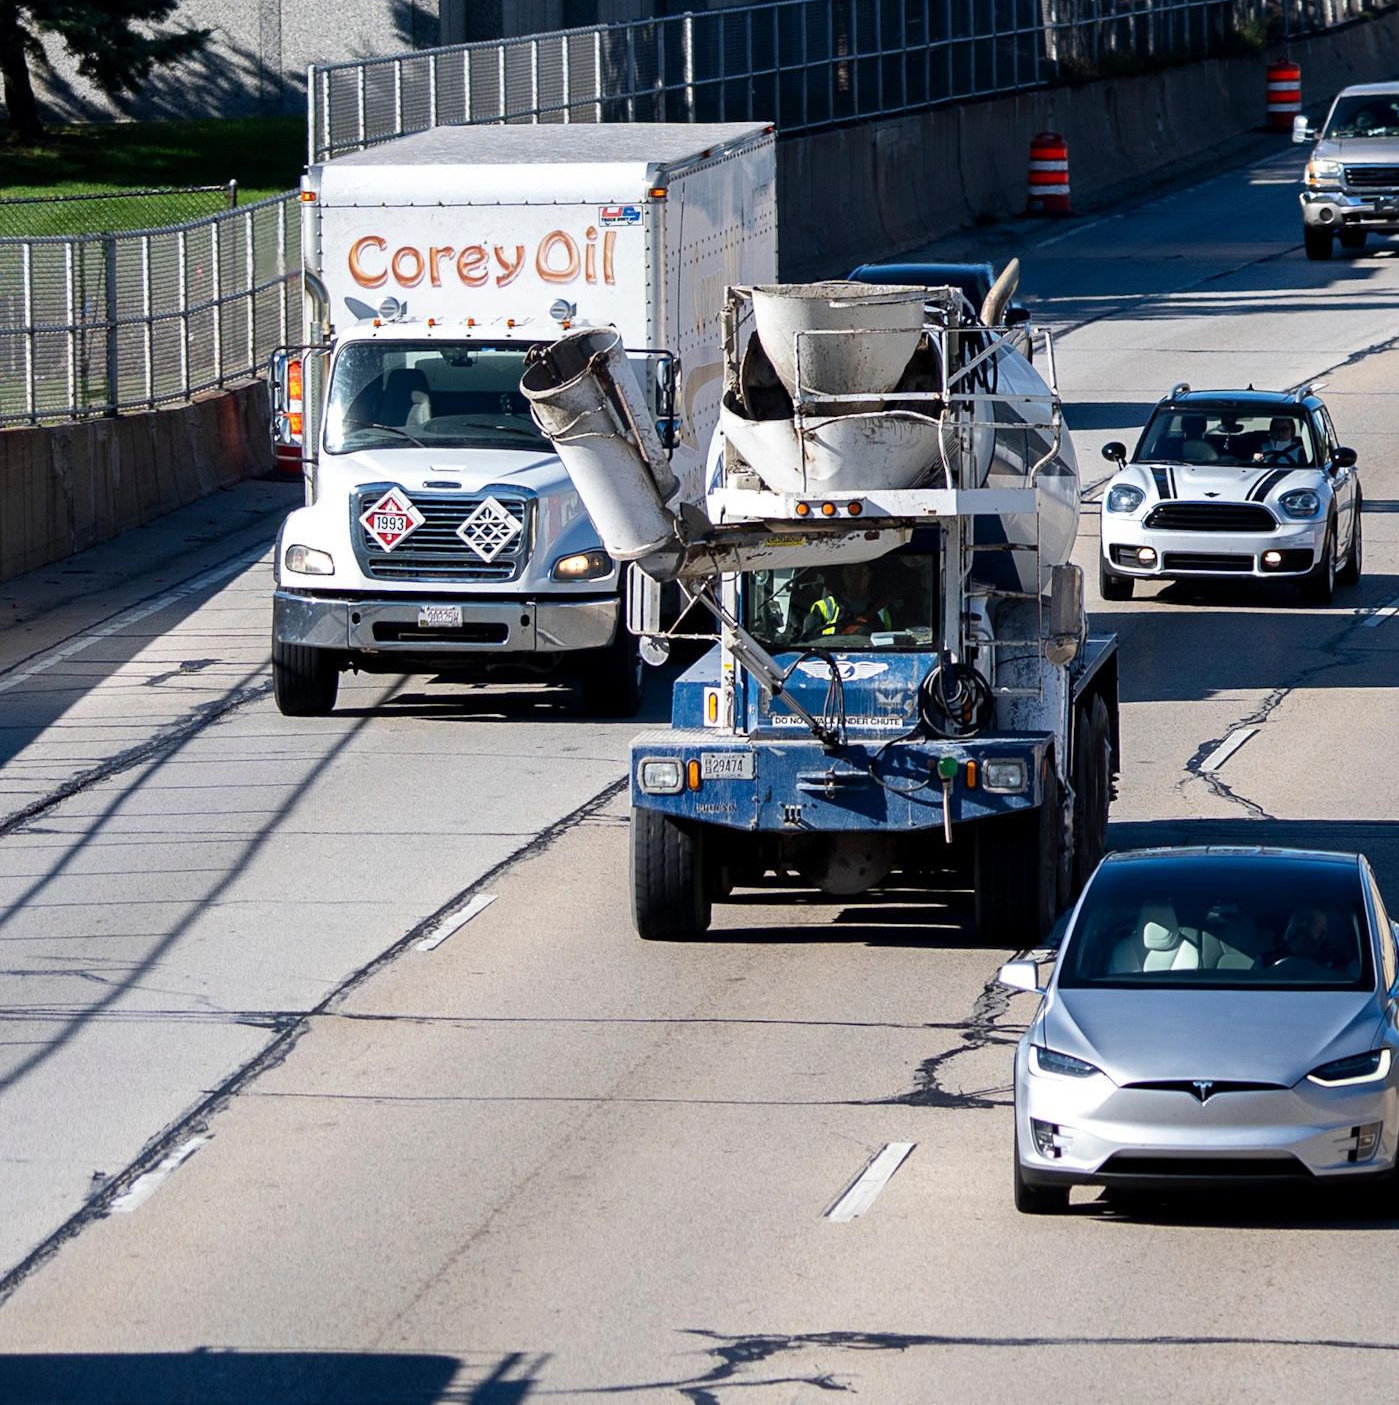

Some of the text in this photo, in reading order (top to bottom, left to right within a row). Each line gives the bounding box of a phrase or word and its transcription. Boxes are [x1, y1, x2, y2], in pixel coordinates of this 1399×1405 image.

[348, 225, 618, 289] Corey Oil
[376, 516, 404, 531] 1993
[386, 533, 393, 541] 3
[775, 717, 788, 725] DO
[870, 718, 901, 726] CHUTE
[713, 759, 743, 773] 29474
